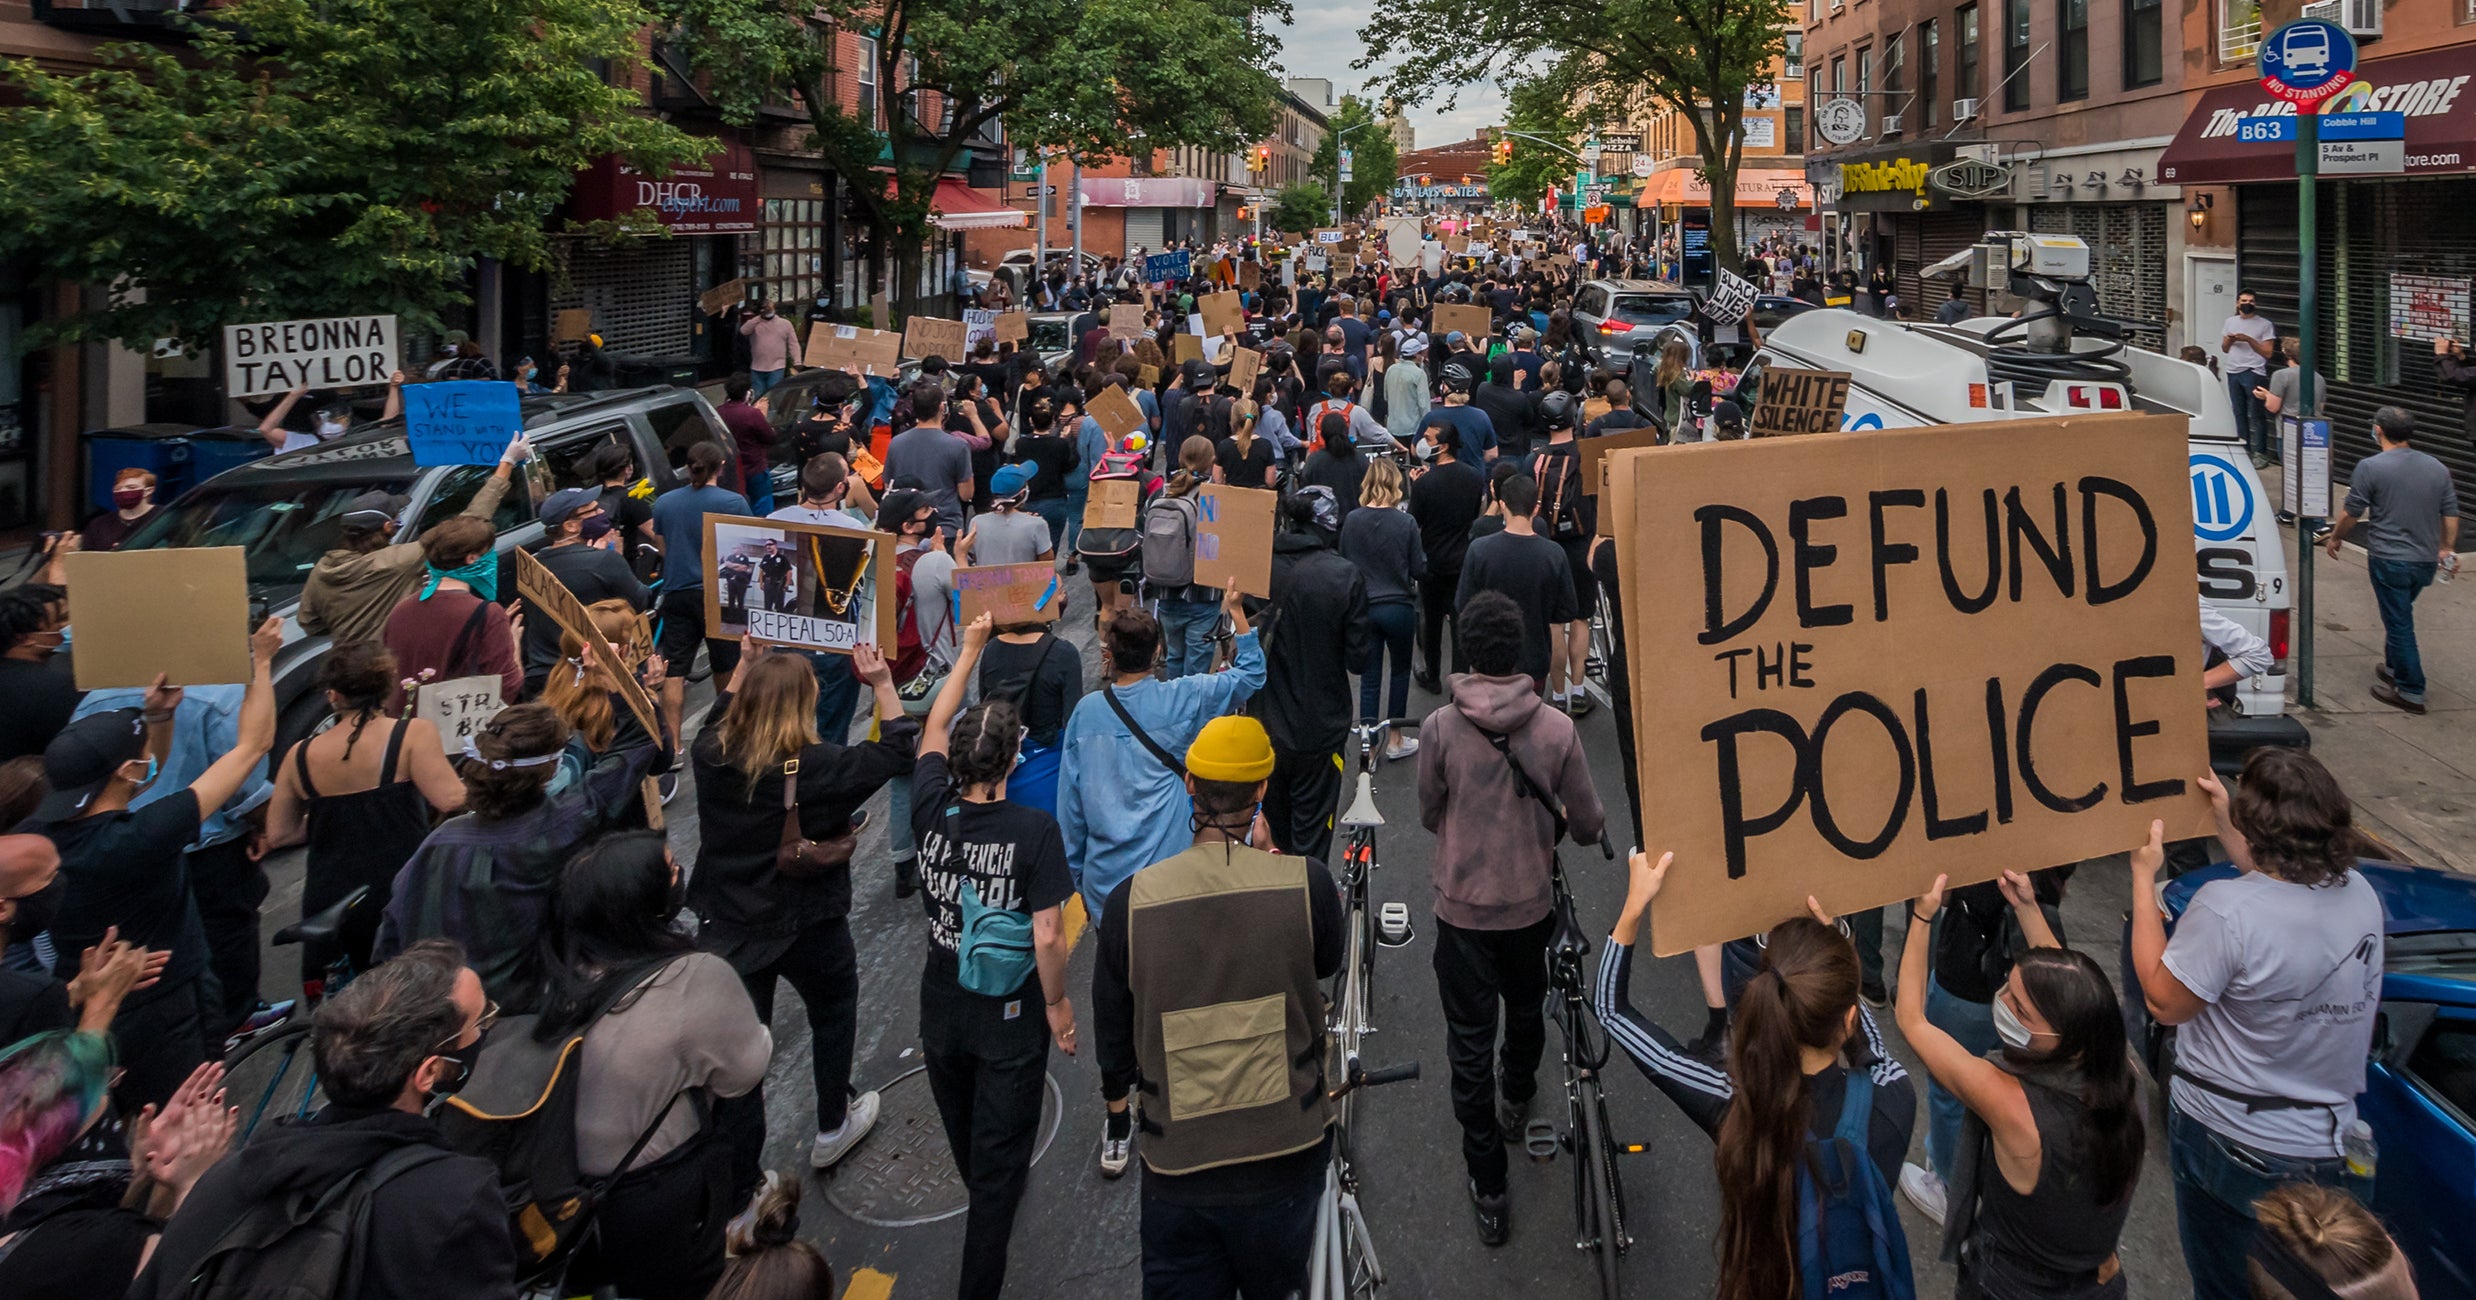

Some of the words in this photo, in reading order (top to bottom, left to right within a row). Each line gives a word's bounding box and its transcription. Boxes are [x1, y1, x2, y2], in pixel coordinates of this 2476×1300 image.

[2267, 79, 2285, 93] NO
[2285, 75, 2347, 99] STANDING
[2362, 76, 2471, 117] STORE
[2200, 108, 2249, 138] The
[2242, 122, 2281, 140] B63
[2323, 118, 2357, 127] Cobble
[2360, 117, 2377, 126] Hill
[1600, 144, 1632, 152] PIZZA
[2322, 153, 2366, 163] Prospect
[2331, 145, 2344, 153] Av
[2403, 152, 2460, 168] tore.com
[1948, 167, 1999, 190] SIP
[2165, 168, 2176, 178] 69
[636, 181, 703, 206] DHCR
[1689, 182, 1710, 192] SLO
[662, 195, 740, 220] expert.com
[1321, 233, 1342, 241] BLM
[1153, 253, 1183, 267] VOTE
[1309, 246, 1326, 257] FUCK
[1149, 264, 1190, 282] FEMINIST
[1721, 270, 1758, 304] BLACK
[1706, 301, 1738, 326] MATTER
[1711, 287, 1750, 317] LIVES
[236, 318, 385, 358] BREONNA
[912, 321, 931, 338] NO
[908, 341, 927, 357] NO
[236, 352, 388, 393] TAYLOR
[1762, 372, 1849, 410] WHITE
[424, 392, 472, 419] WE
[415, 423, 466, 438] STAND
[1753, 405, 1838, 433] SILENCE
[1694, 476, 2157, 645] DEFUND
[2273, 577, 2282, 594] 9
[750, 611, 822, 643] REPEAL
[825, 623, 855, 643] 50-A
[1714, 641, 1816, 699] THE
[1700, 656, 2186, 880] POLICE
